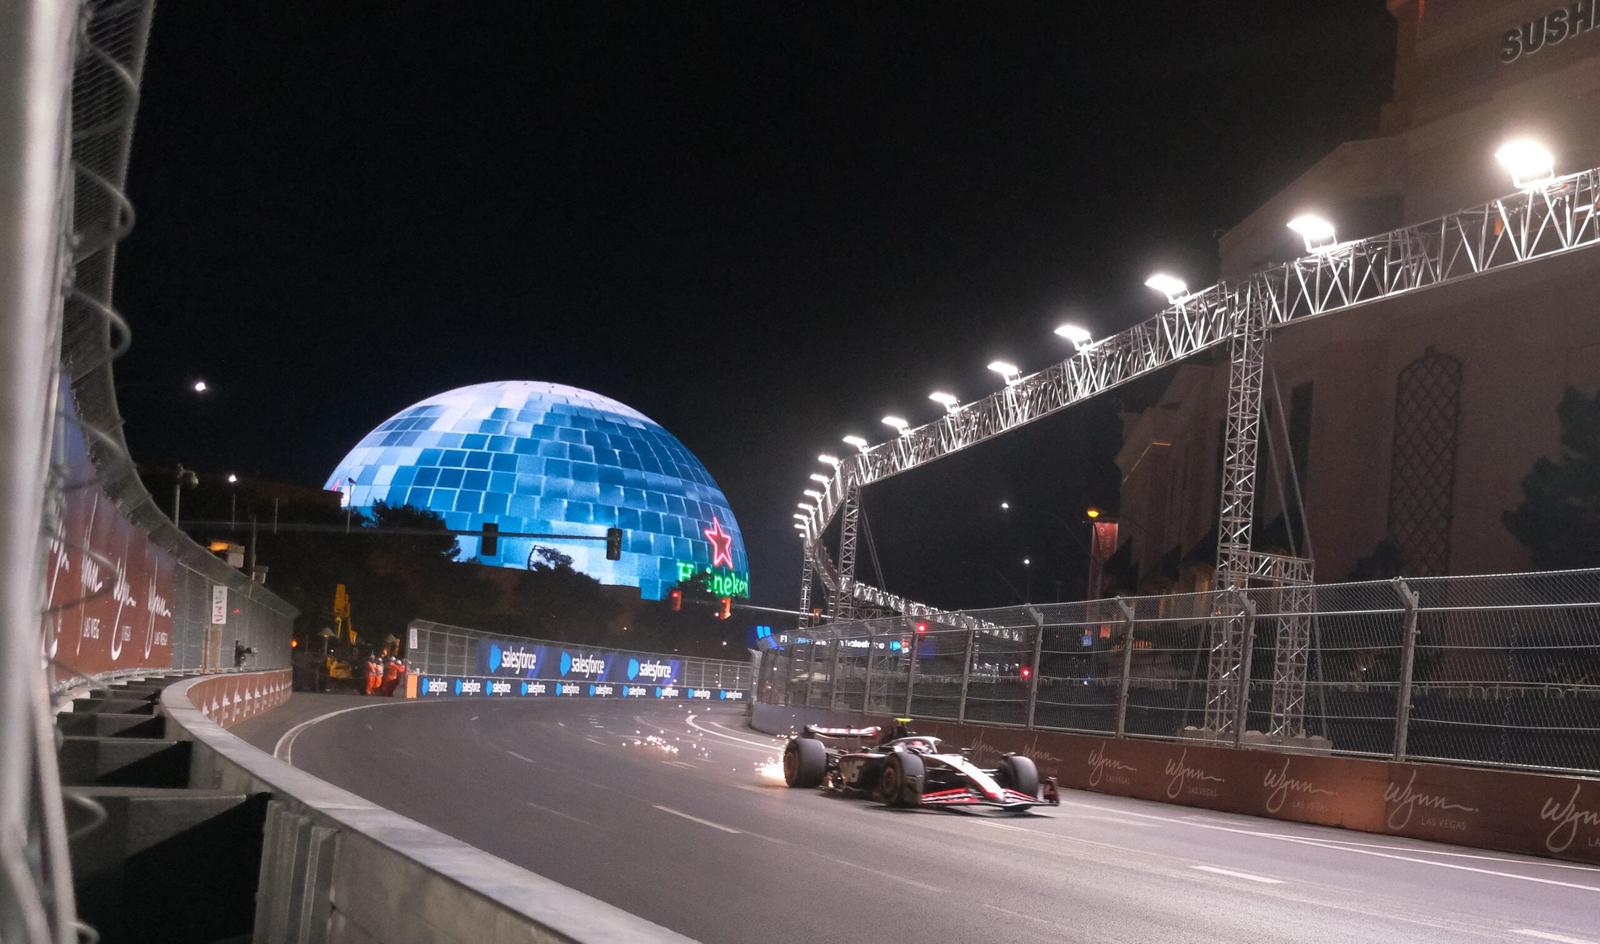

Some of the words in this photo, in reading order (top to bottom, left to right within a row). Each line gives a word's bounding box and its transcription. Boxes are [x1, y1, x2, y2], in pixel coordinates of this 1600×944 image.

[1501, 0, 1600, 63] SUSH
[676, 562, 749, 597] Hneken
[502, 645, 537, 675] salesforce
[571, 653, 605, 682] salesforce
[639, 659, 673, 682] salesforce
[1087, 740, 1137, 786] Wynn
[1165, 748, 1225, 799] Wynn
[1264, 758, 1338, 814] Wynn
[1384, 769, 1479, 830] Wynn
[1421, 816, 1437, 827] LAS
[1439, 818, 1467, 831] VEGAS
